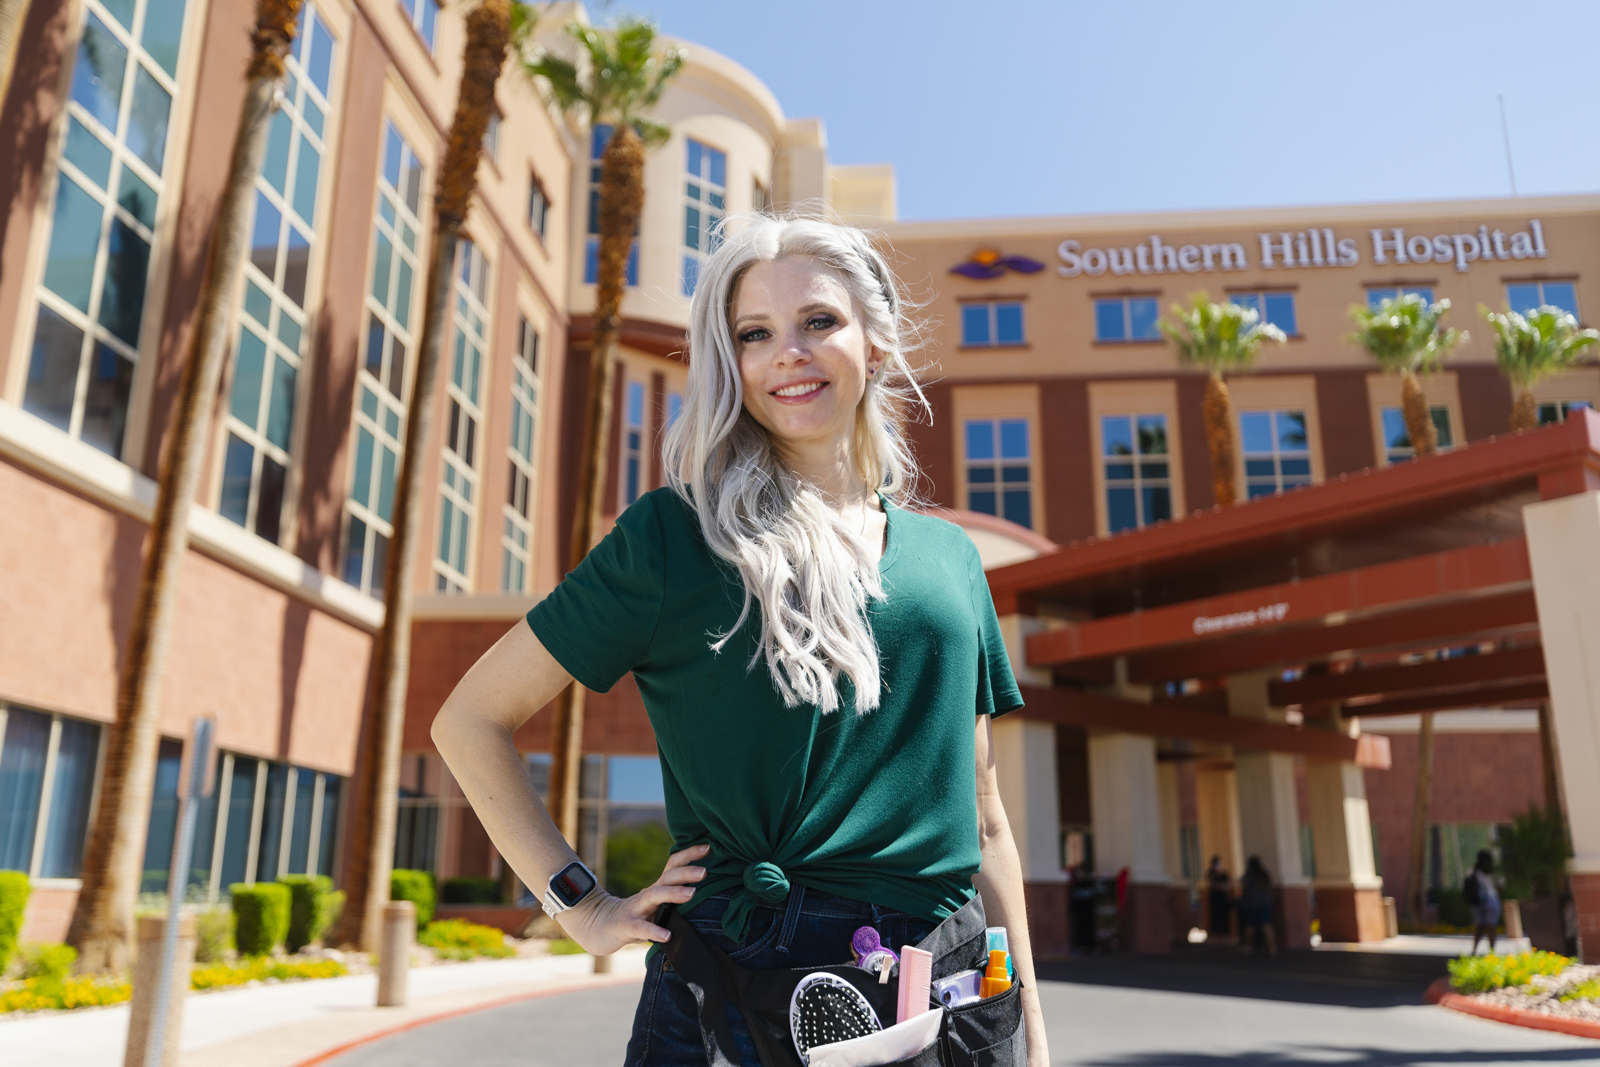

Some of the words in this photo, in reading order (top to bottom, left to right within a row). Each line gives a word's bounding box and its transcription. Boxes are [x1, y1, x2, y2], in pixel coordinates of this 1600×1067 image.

[1057, 235, 1248, 278] Southern
[1257, 228, 1359, 269] Hills
[1369, 219, 1548, 272] Hospital
[1193, 610, 1257, 634] Clearance
